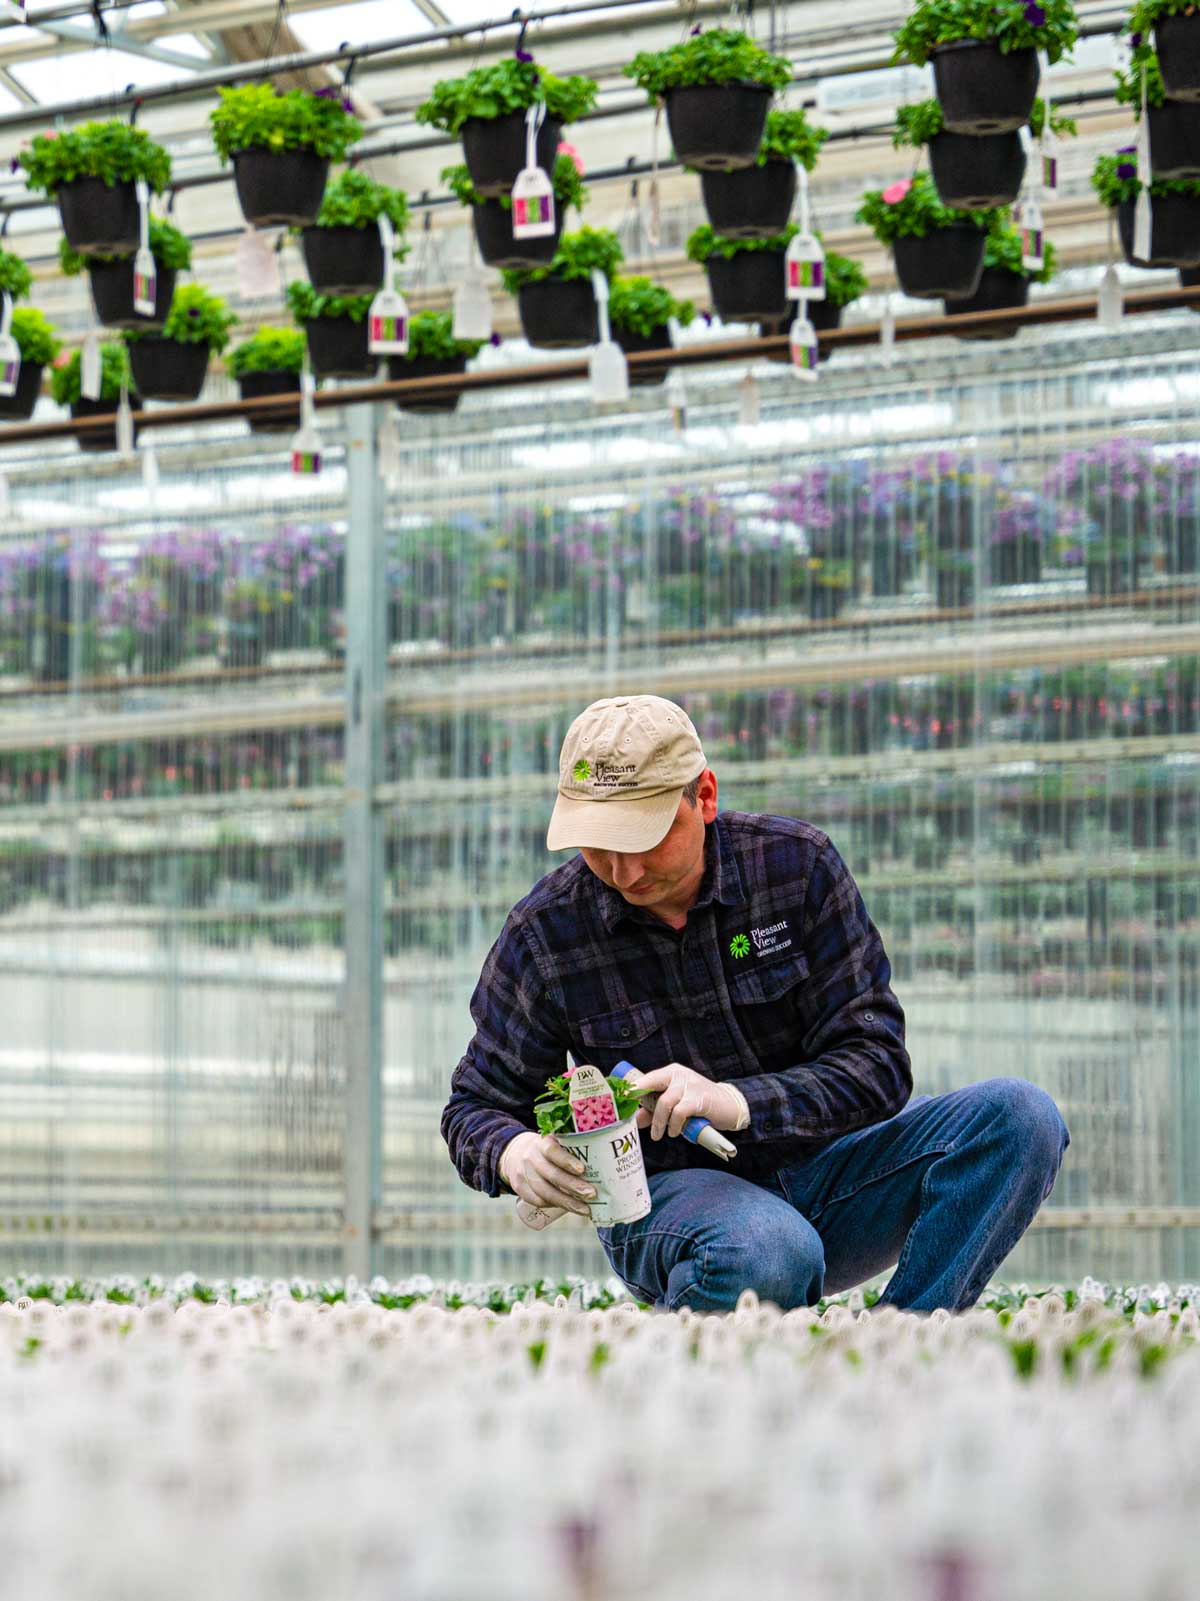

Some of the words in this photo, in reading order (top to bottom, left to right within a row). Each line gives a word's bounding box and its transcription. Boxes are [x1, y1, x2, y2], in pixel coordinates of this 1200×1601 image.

[595, 761, 636, 775] Pleasant
[596, 773, 622, 782] View
[750, 920, 788, 940] Pleasant
[754, 936, 776, 949] View
[609, 1127, 638, 1159] PW
